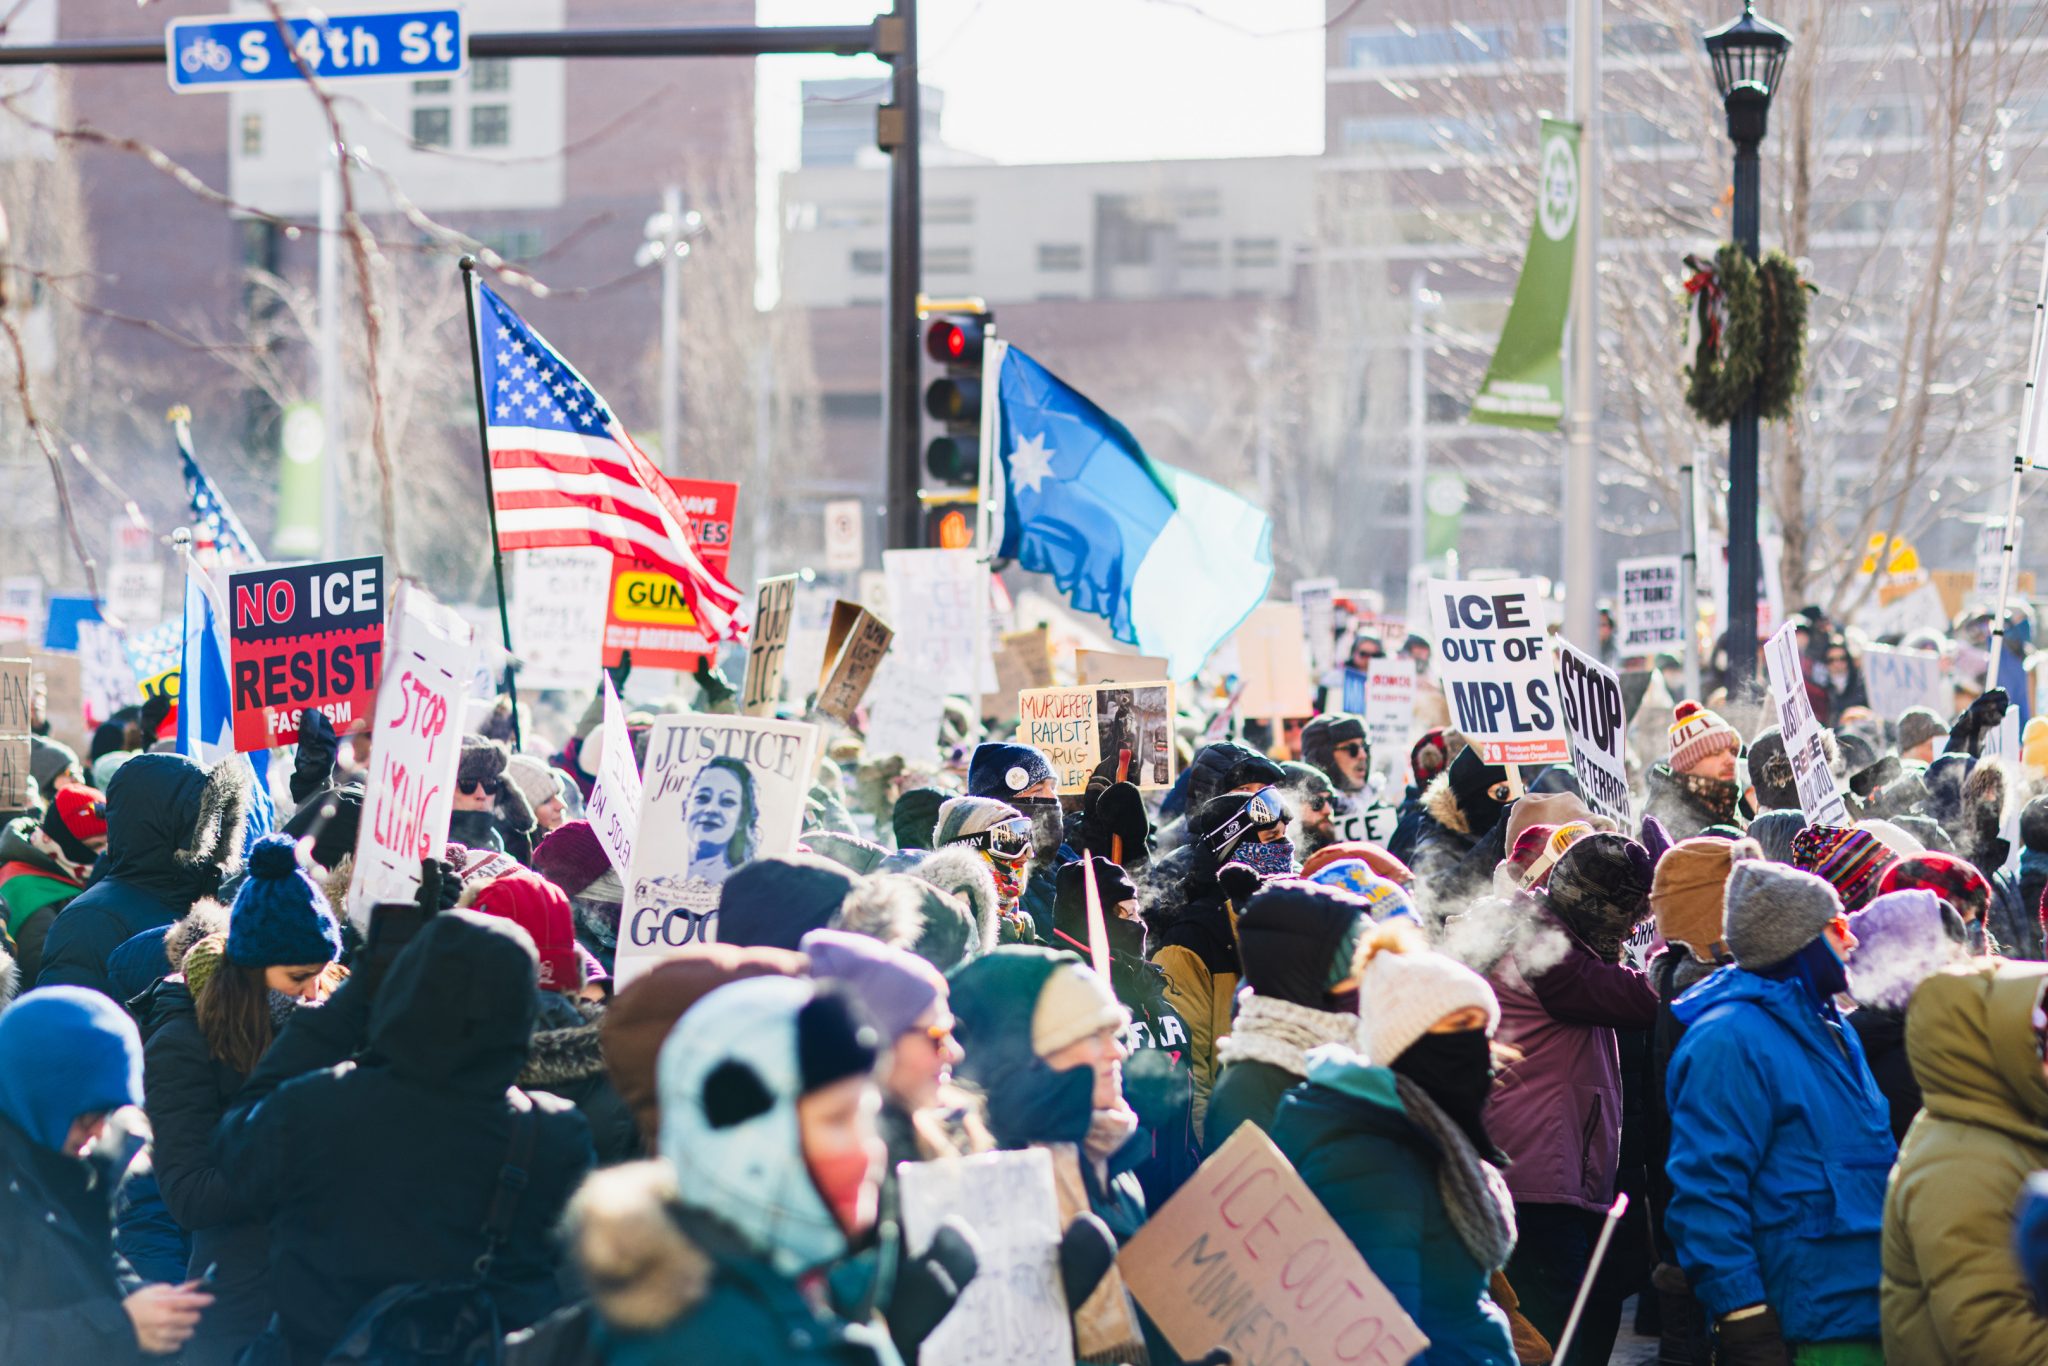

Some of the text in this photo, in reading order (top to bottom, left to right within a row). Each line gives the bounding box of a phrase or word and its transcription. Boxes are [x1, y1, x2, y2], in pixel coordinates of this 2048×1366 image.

[239, 21, 454, 73] S 4th St
[237, 568, 377, 629] NO ICE
[628, 581, 687, 607] GUN
[1444, 593, 1531, 630] ICE
[235, 641, 381, 711] RESIST
[1442, 637, 1543, 662] OUT OF
[267, 701, 351, 735] FASSM
[389, 671, 447, 763] STOP
[1452, 679, 1555, 733] MPLS
[1562, 648, 1622, 758] STOP
[656, 726, 801, 781] JUSTICE
[1031, 720, 1091, 745] RAPIST?
[374, 752, 440, 864] LYING
[592, 784, 607, 819] ON
[652, 765, 691, 803] for
[1587, 758, 1631, 818] TERROR
[1334, 815, 1382, 841] CE
[1211, 1149, 1408, 1366] ICE OUT OF
